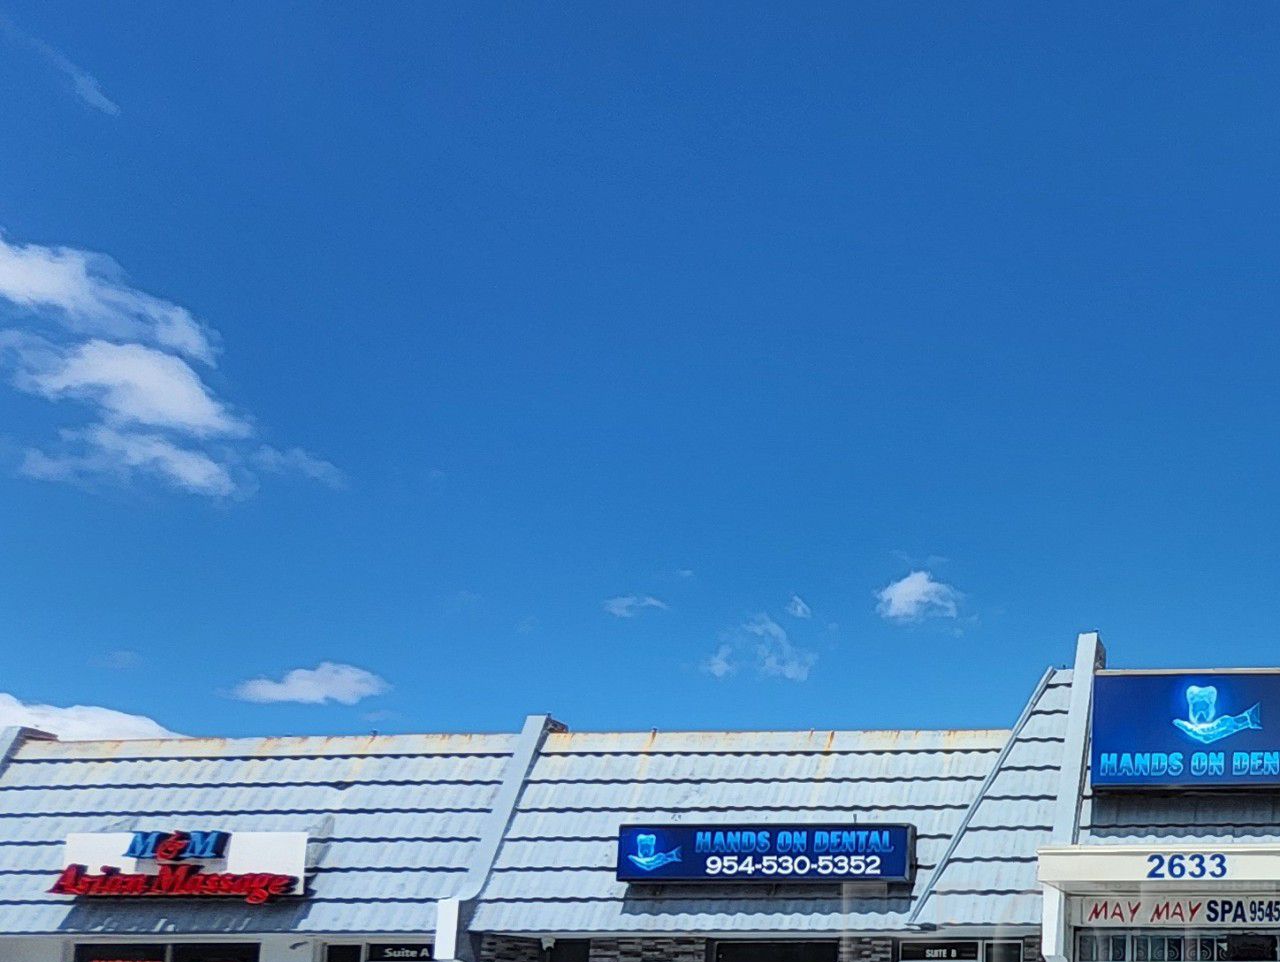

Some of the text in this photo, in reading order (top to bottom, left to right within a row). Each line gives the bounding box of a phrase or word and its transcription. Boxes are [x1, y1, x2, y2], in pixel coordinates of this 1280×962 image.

[1100, 752, 1183, 777] HANDS
[1191, 752, 1225, 776] ON
[123, 831, 160, 857] M
[184, 831, 230, 858] M
[696, 830, 894, 853] HANDS ON DENTAL
[705, 855, 881, 875] 954-530-5352
[1147, 853, 1227, 878] 2633
[45, 864, 294, 904] Asian Massage
[1088, 901, 1141, 922] MAY
[1150, 901, 1201, 922] MAY
[1206, 901, 1247, 922] SPA
[384, 948, 429, 957] Suite A
[926, 949, 947, 957] SUITE
